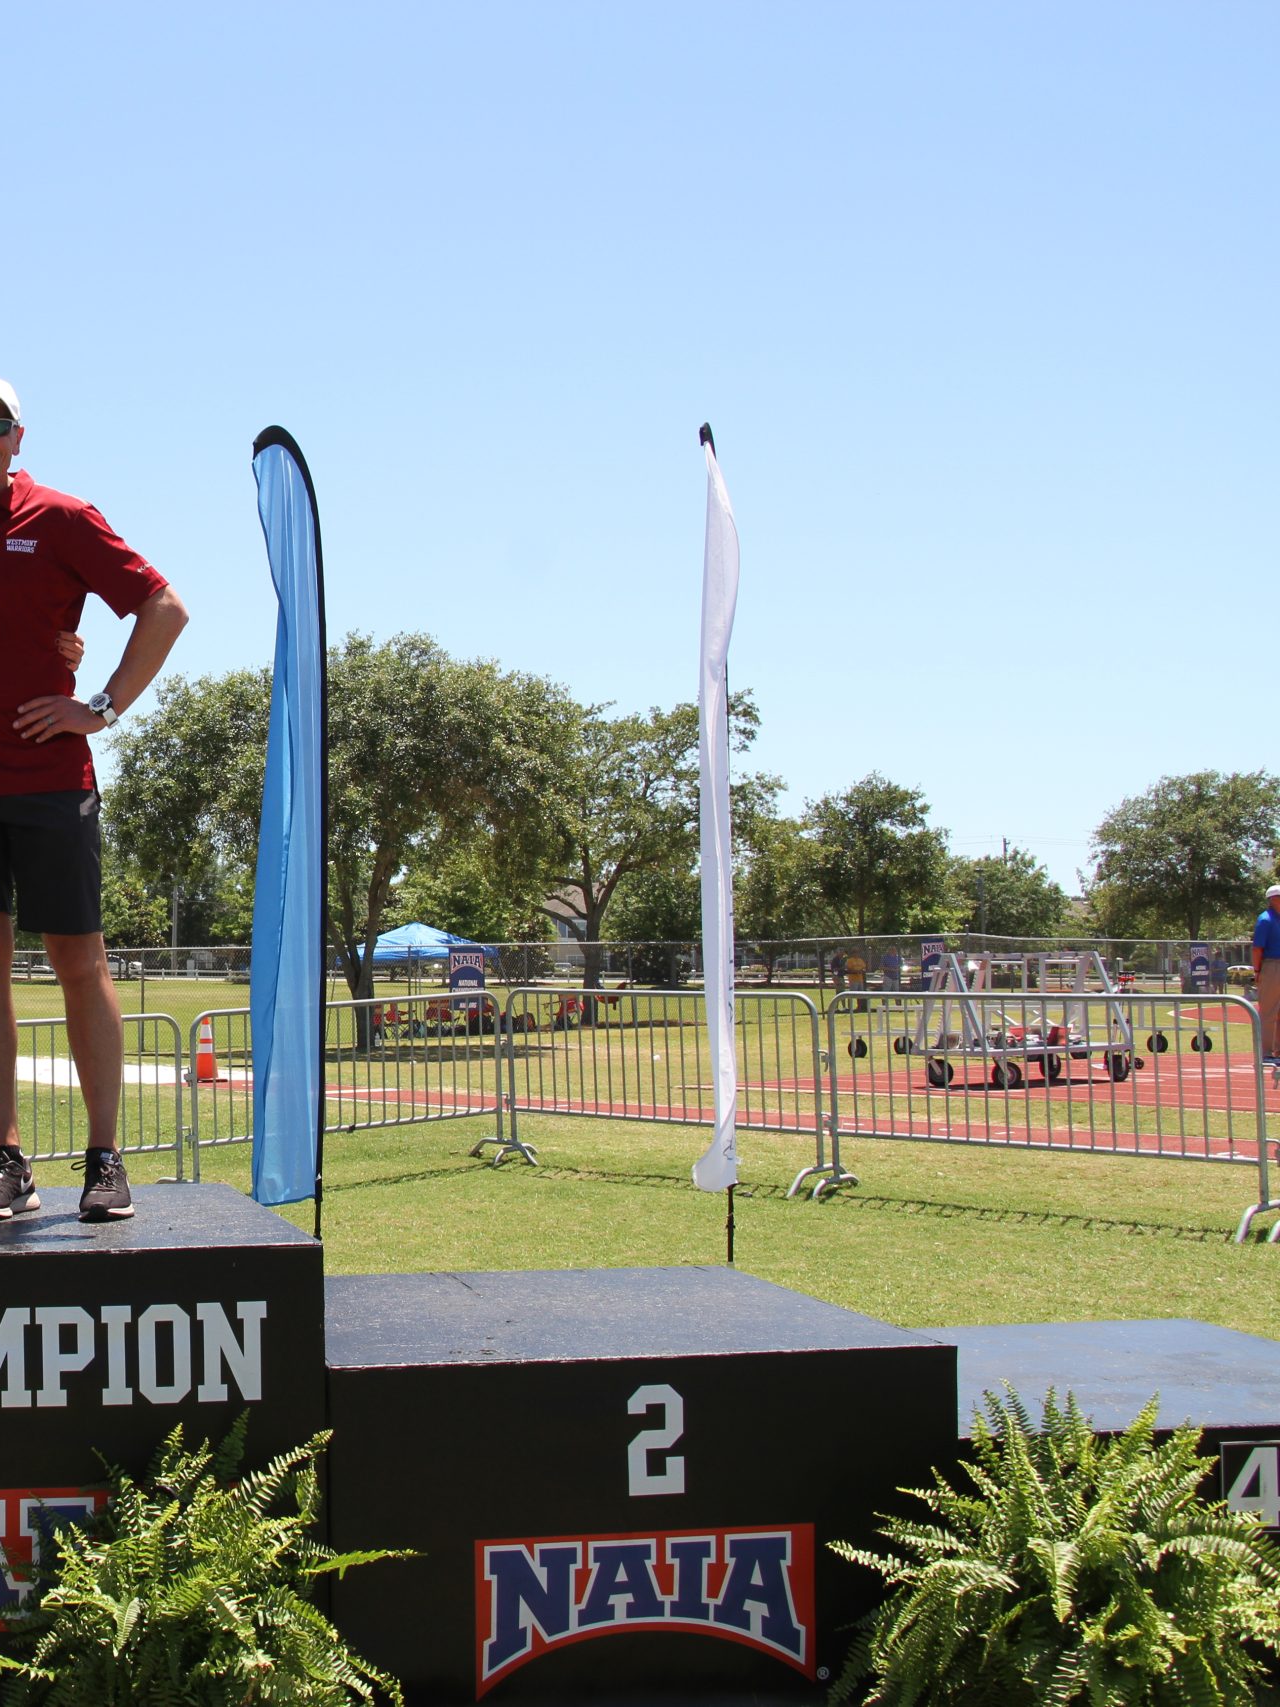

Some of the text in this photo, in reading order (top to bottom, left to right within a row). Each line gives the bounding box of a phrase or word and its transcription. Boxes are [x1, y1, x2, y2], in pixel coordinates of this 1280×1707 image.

[6, 538, 38, 547] WESTMONT
[6, 545, 35, 554] WARRIORS
[452, 955, 482, 969] NAIA
[627, 1384, 685, 1496] 2
[1227, 1447, 1280, 1527] 4
[482, 1531, 806, 1682] NAIA
